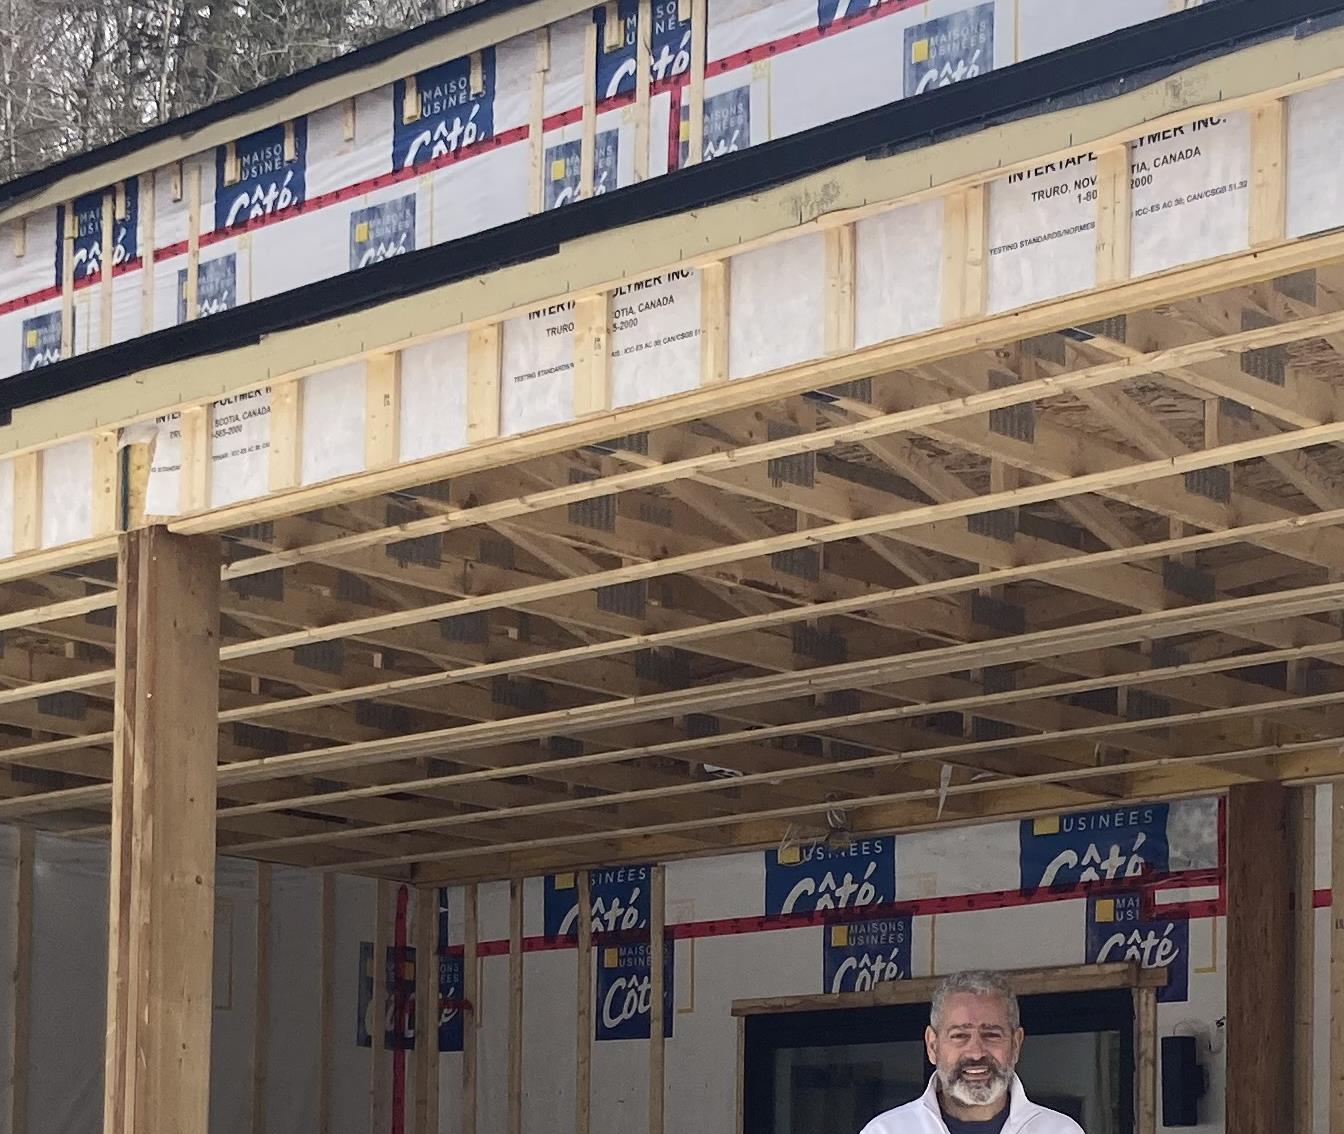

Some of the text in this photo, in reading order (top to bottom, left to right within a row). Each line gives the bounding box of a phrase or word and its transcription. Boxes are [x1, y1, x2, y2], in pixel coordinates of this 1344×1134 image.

[422, 72, 487, 103] MAISO
[1074, 174, 1098, 191] NOV
[1153, 146, 1202, 169] CANADA
[638, 294, 675, 314] CANADA
[1062, 807, 1154, 833] USINÉES
[848, 921, 905, 934] MAISONS
[848, 932, 905, 947] USINÉES
[602, 974, 652, 1029] Côt
